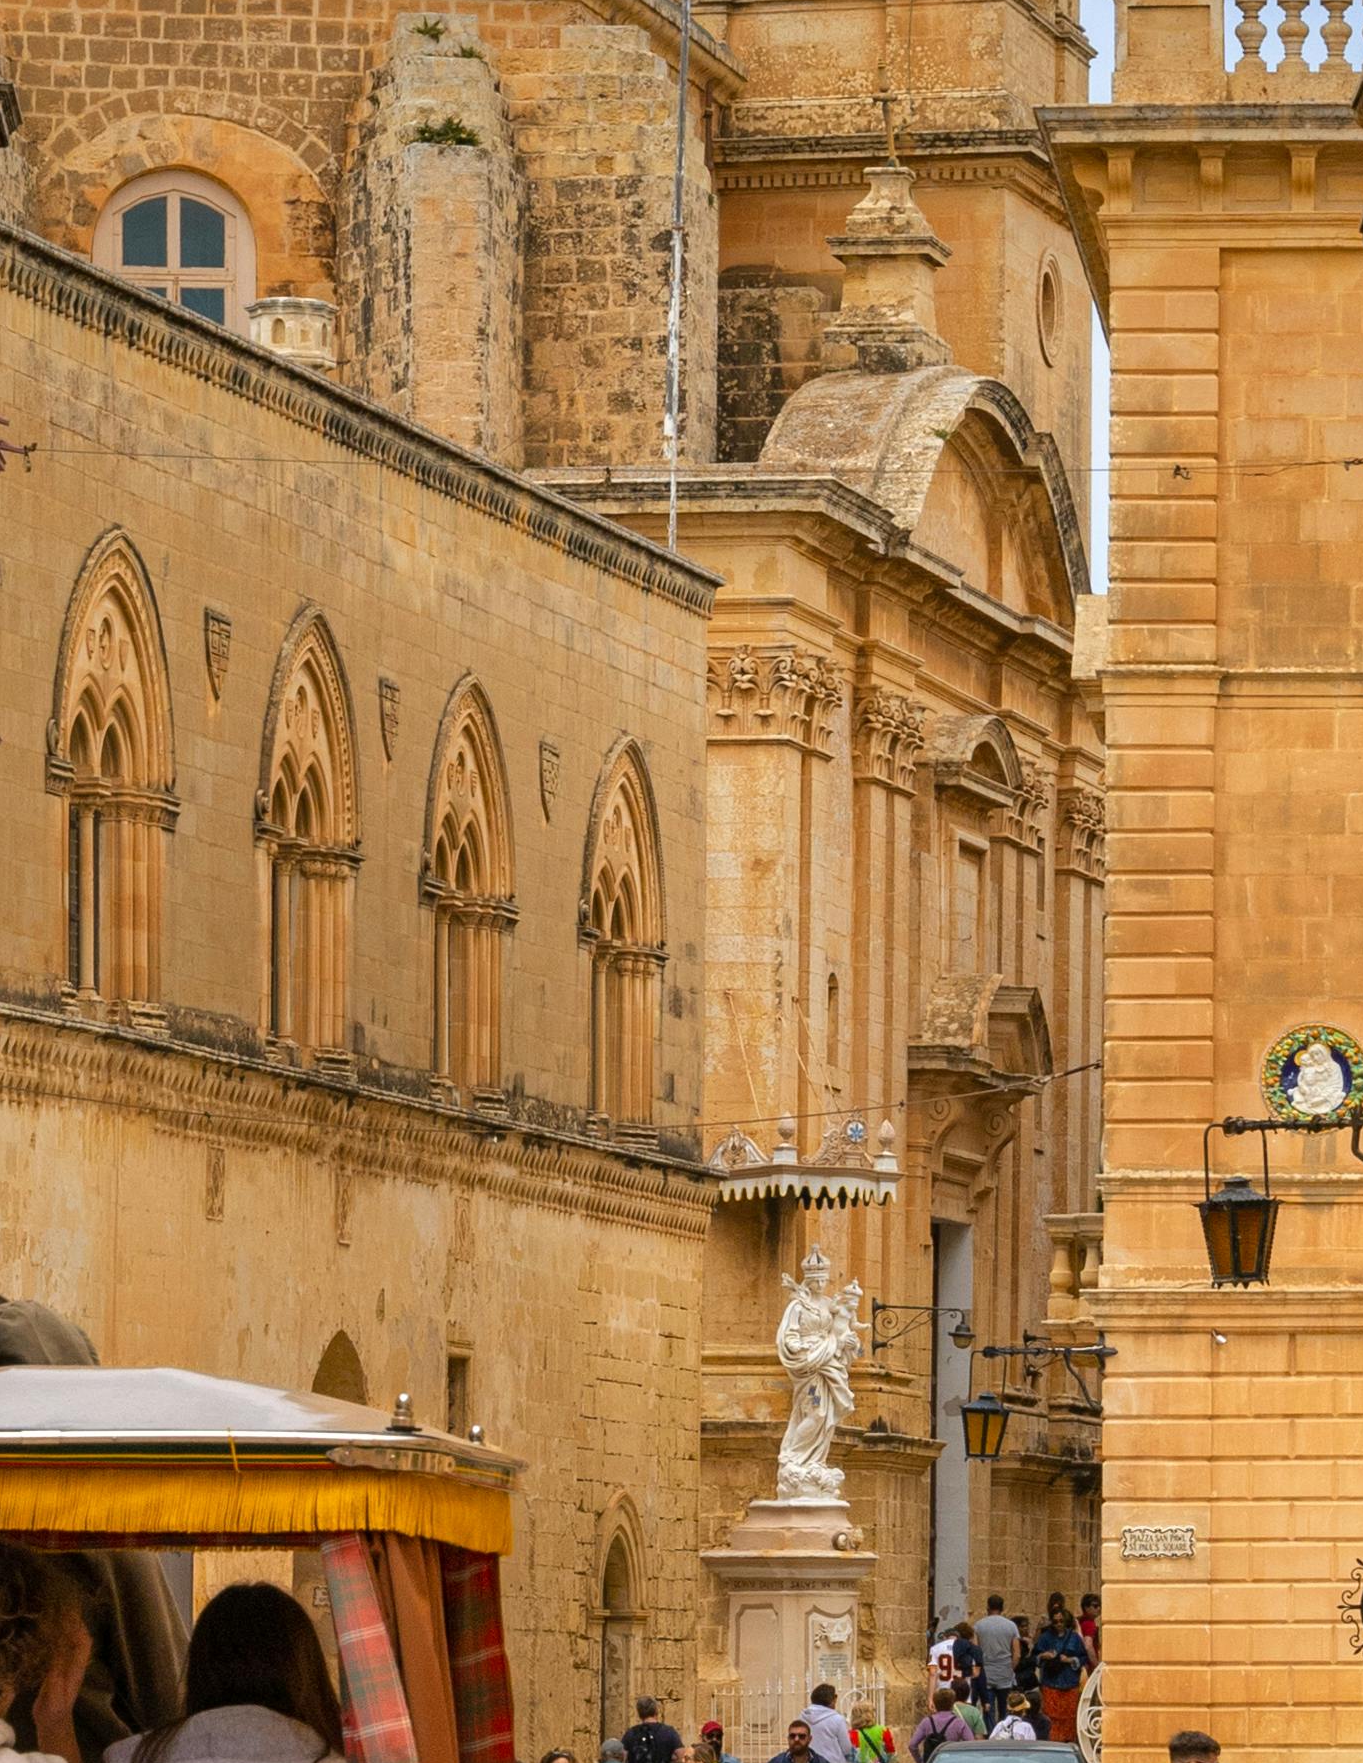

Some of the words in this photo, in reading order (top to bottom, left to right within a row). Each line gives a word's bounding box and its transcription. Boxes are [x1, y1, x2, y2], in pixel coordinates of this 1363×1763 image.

[1129, 1534, 1154, 1542] PIAZZA
[1155, 1534, 1168, 1542] SAN
[1163, 1543, 1188, 1552] SQUARE
